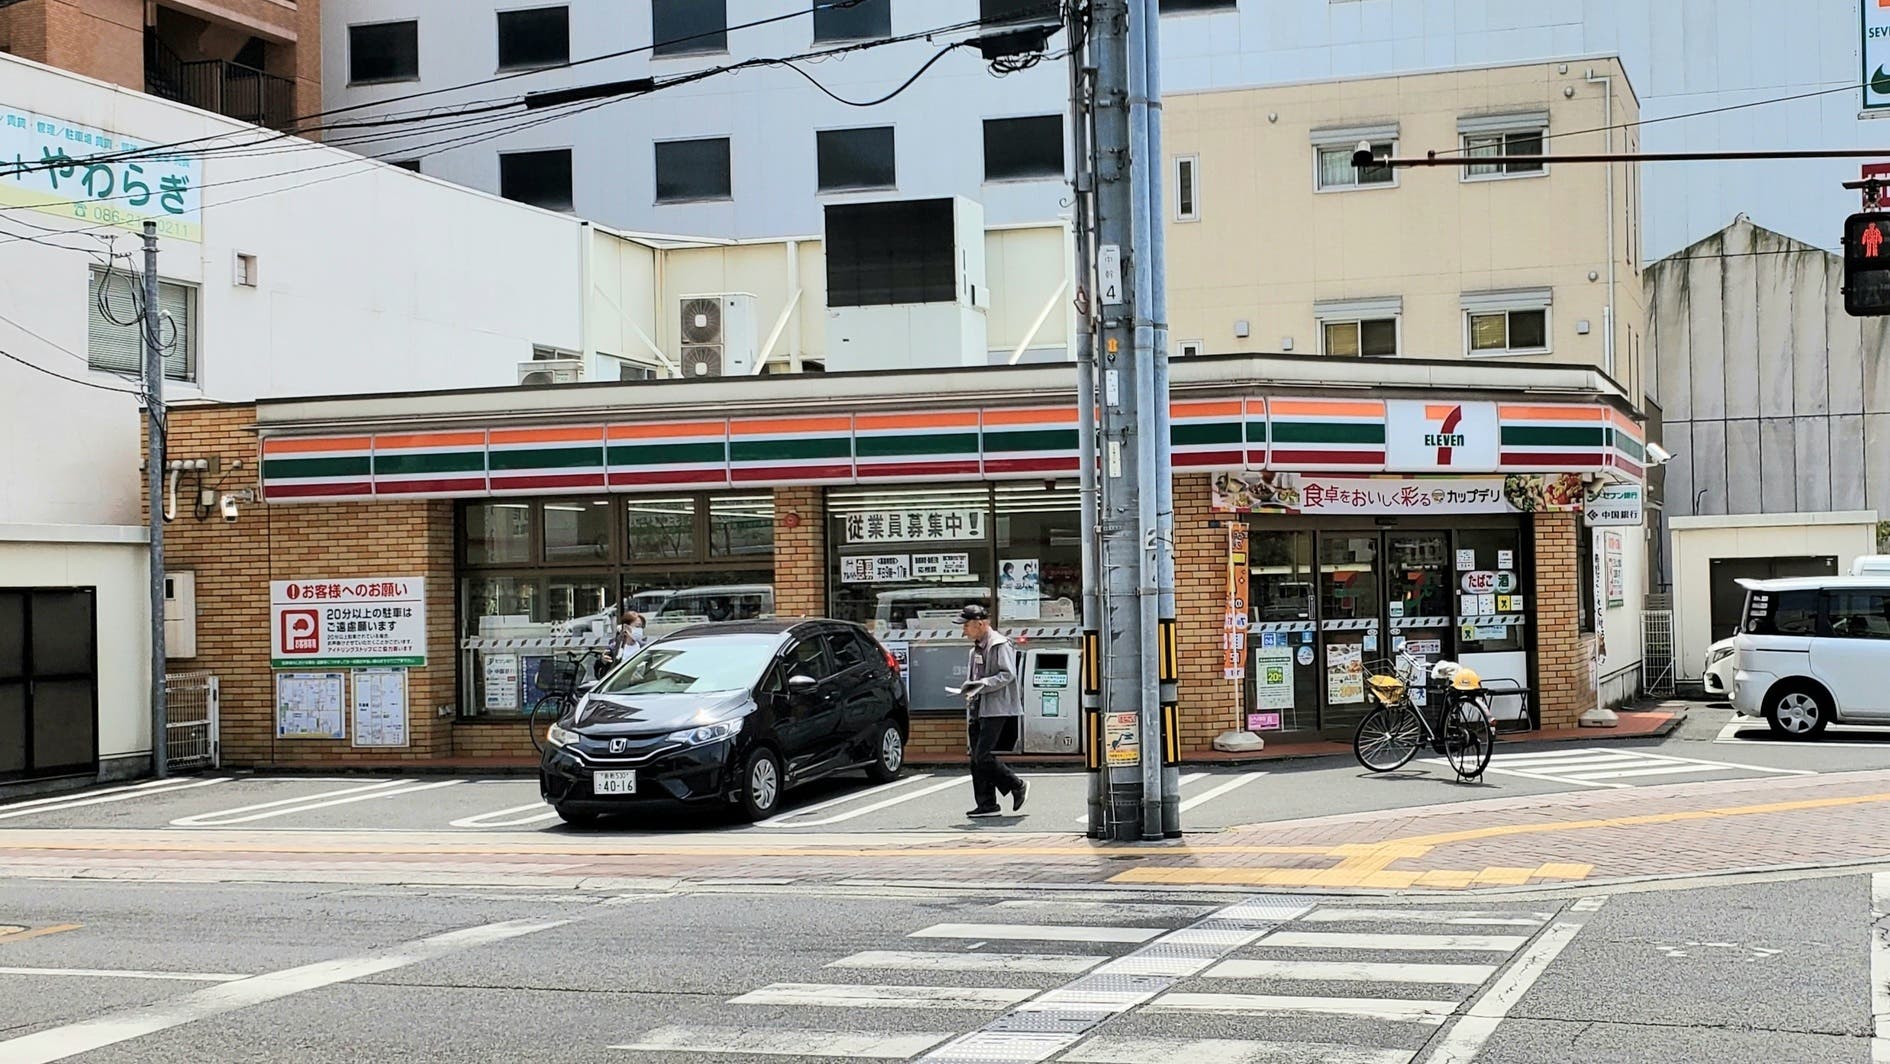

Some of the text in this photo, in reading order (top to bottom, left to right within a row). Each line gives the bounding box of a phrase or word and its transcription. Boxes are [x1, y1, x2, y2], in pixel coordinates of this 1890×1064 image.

[1869, 26, 1890, 38] SEV
[41, 146, 189, 214] やわらぎ
[1425, 405, 1462, 465] 7
[1303, 483, 1501, 508] 食卓をおいしく彩る カップデリ
[1601, 510, 1638, 519] 中国銀行
[848, 511, 979, 540] 従業員募集中!
[1468, 574, 1509, 588] たばこ 酒
[302, 582, 408, 599] お客様へのお願い
[327, 607, 412, 620] 20分以上の駐車は
[327, 621, 397, 632] ご遠慮願います
[604, 780, 633, 792] 40-16
